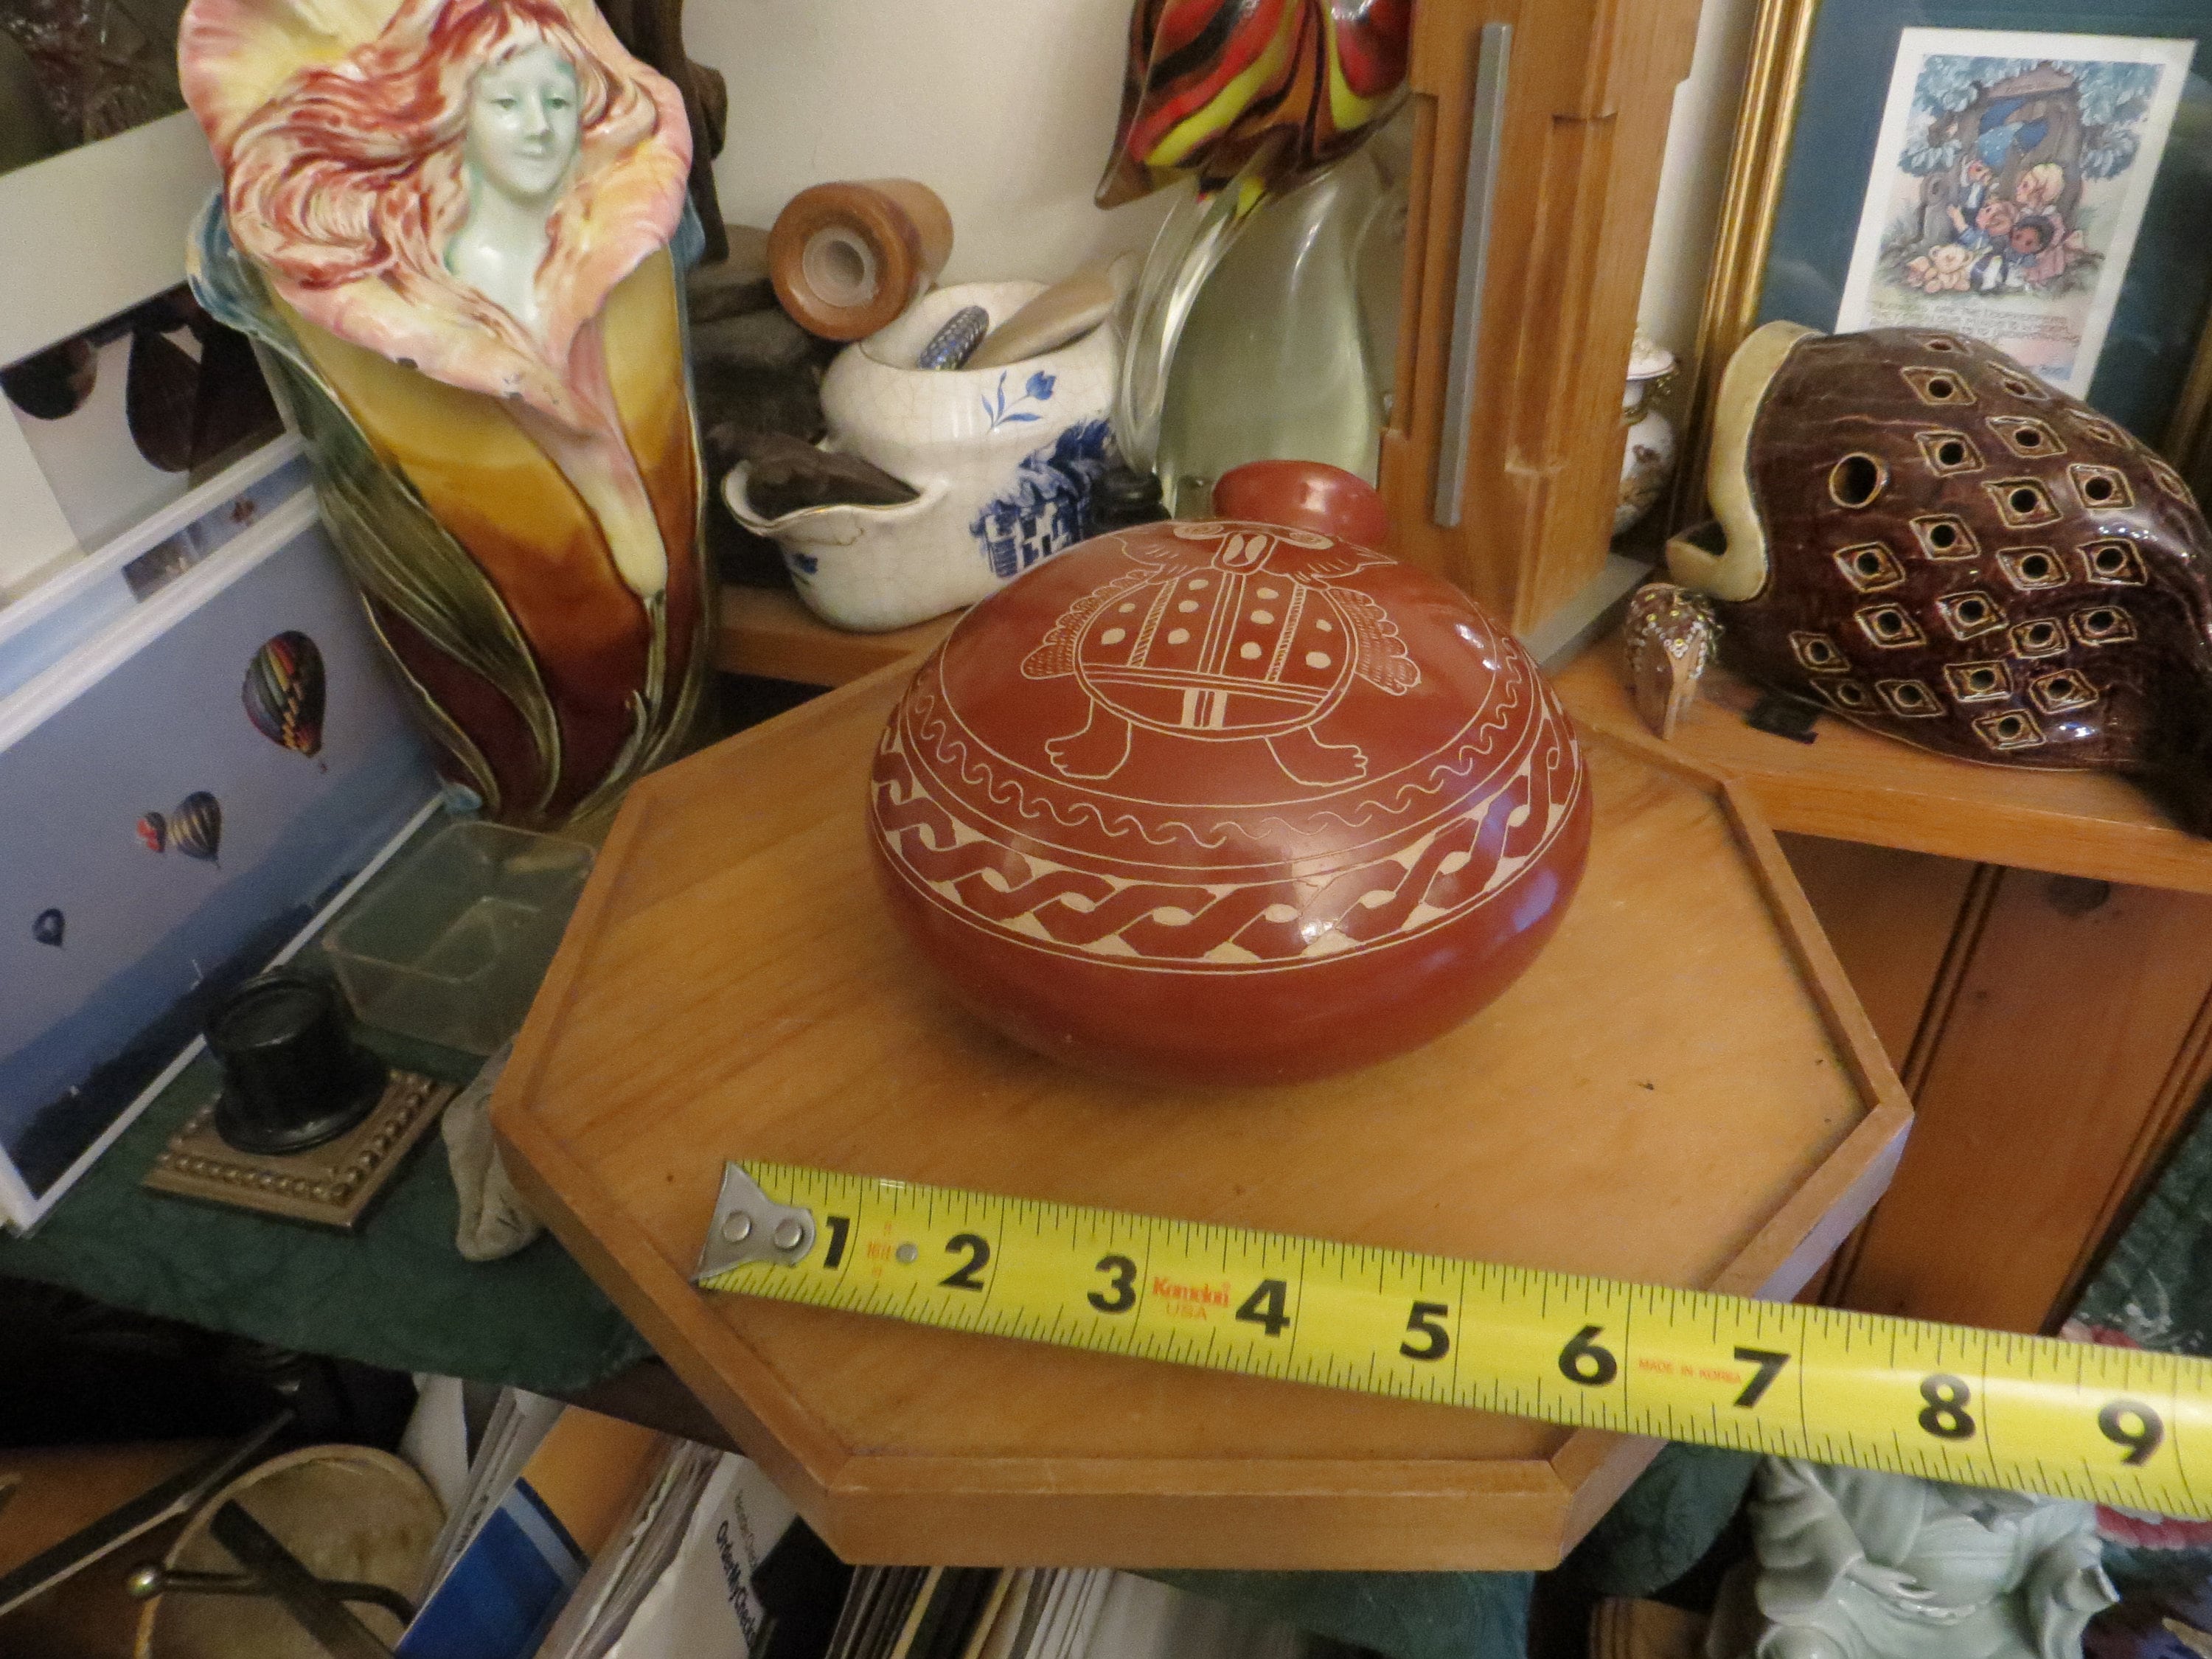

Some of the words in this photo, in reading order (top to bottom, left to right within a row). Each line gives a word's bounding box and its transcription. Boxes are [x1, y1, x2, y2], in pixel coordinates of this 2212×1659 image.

[1166, 1301, 1208, 1321] USA
[824, 1215, 850, 1269] 1
[939, 1233, 990, 1292] 2
[1088, 1254, 1136, 1313] 3
[1236, 1279, 1290, 1337] 4
[1399, 1302, 1449, 1361] 5
[1559, 1325, 1616, 1386] 6
[1734, 1346, 1790, 1408] 7
[1919, 1374, 1976, 1441] 8
[2098, 1399, 2164, 1466] 9
[1638, 1359, 1672, 1374] MADE
[1680, 1366, 1694, 1377] IN
